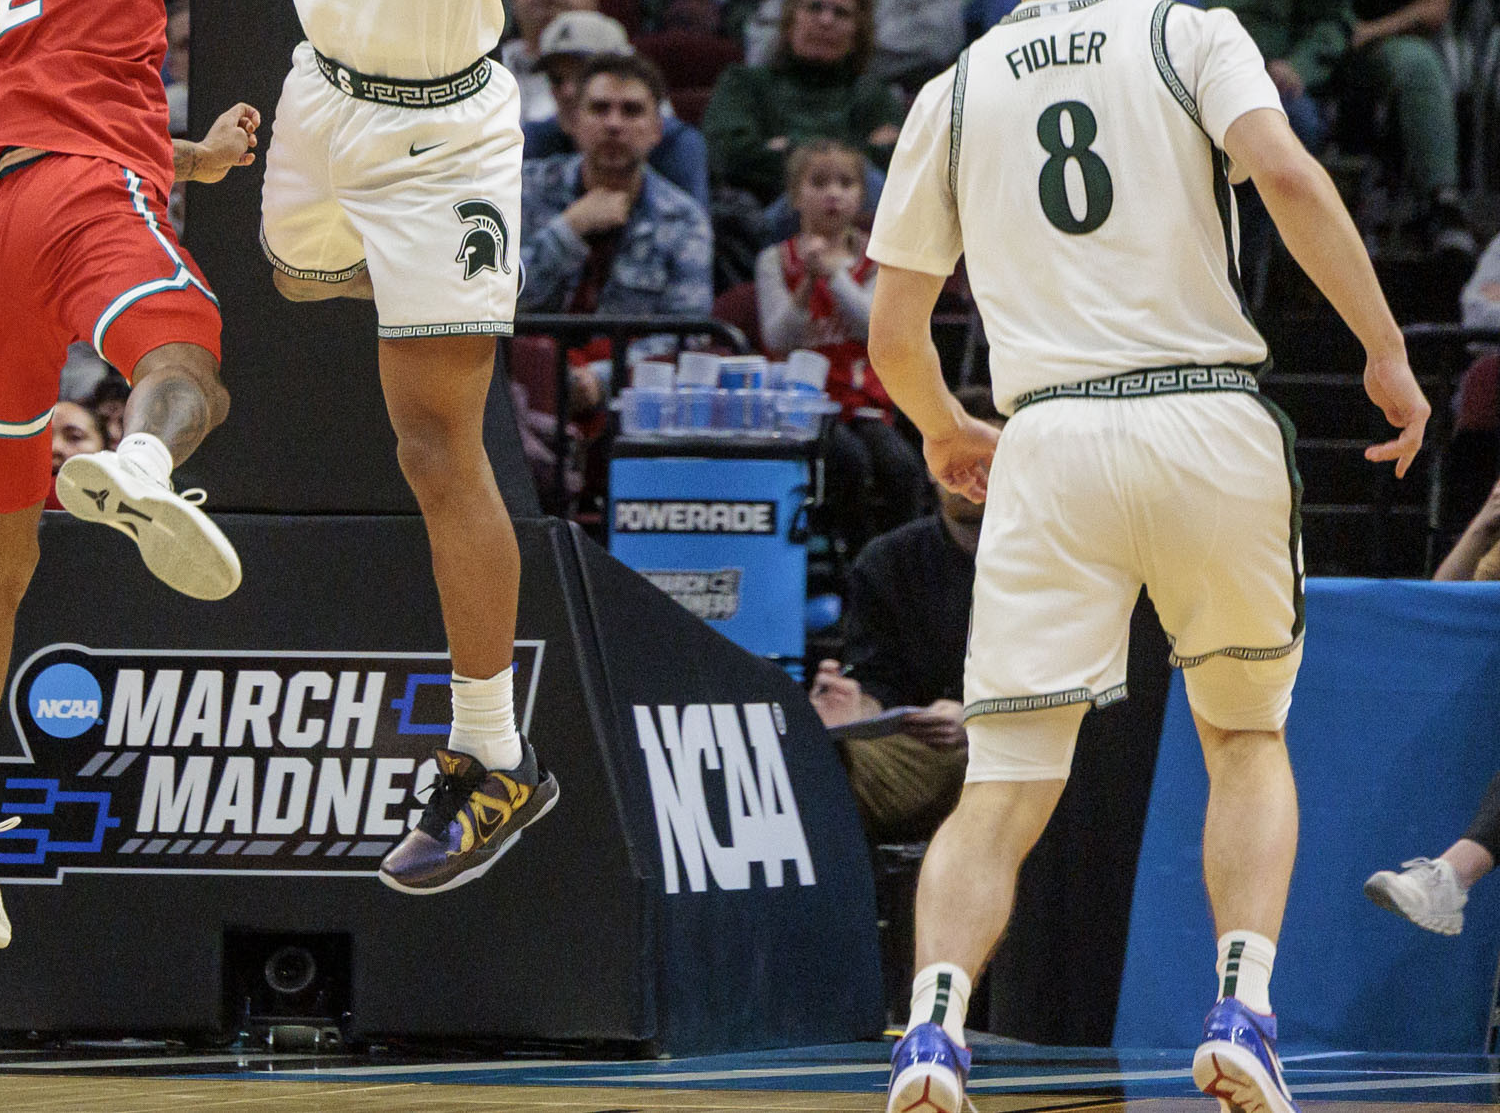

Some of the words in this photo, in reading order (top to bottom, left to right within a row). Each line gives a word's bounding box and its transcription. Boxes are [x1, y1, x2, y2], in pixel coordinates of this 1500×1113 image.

[1005, 31, 1107, 80] FIDLER
[1037, 100, 1113, 235] 8
[615, 502, 772, 532] POWERADE
[36, 699, 99, 719] NCAA
[104, 669, 386, 748] MARCH
[136, 757, 440, 834] MADNES
[633, 702, 817, 894] NCAA
